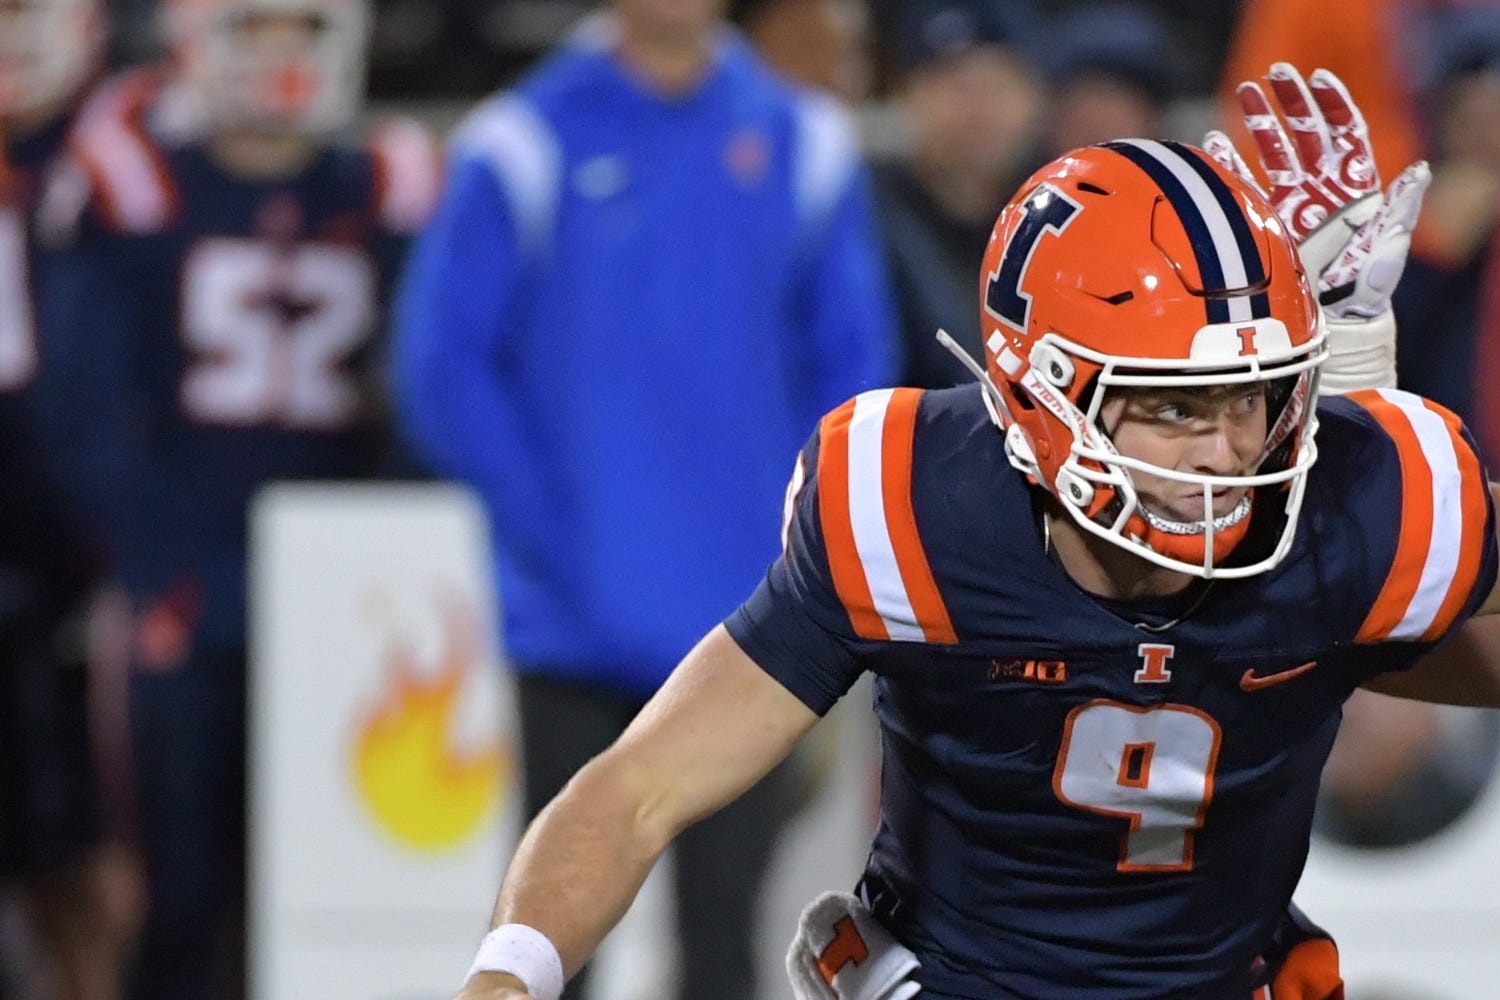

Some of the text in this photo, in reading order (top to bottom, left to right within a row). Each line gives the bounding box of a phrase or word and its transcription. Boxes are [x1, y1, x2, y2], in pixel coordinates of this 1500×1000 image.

[180, 237, 378, 427] 52
[984, 181, 1085, 335] I
[1237, 327, 1258, 356] I
[1133, 642, 1176, 684] I
[1052, 697, 1223, 873] 9
